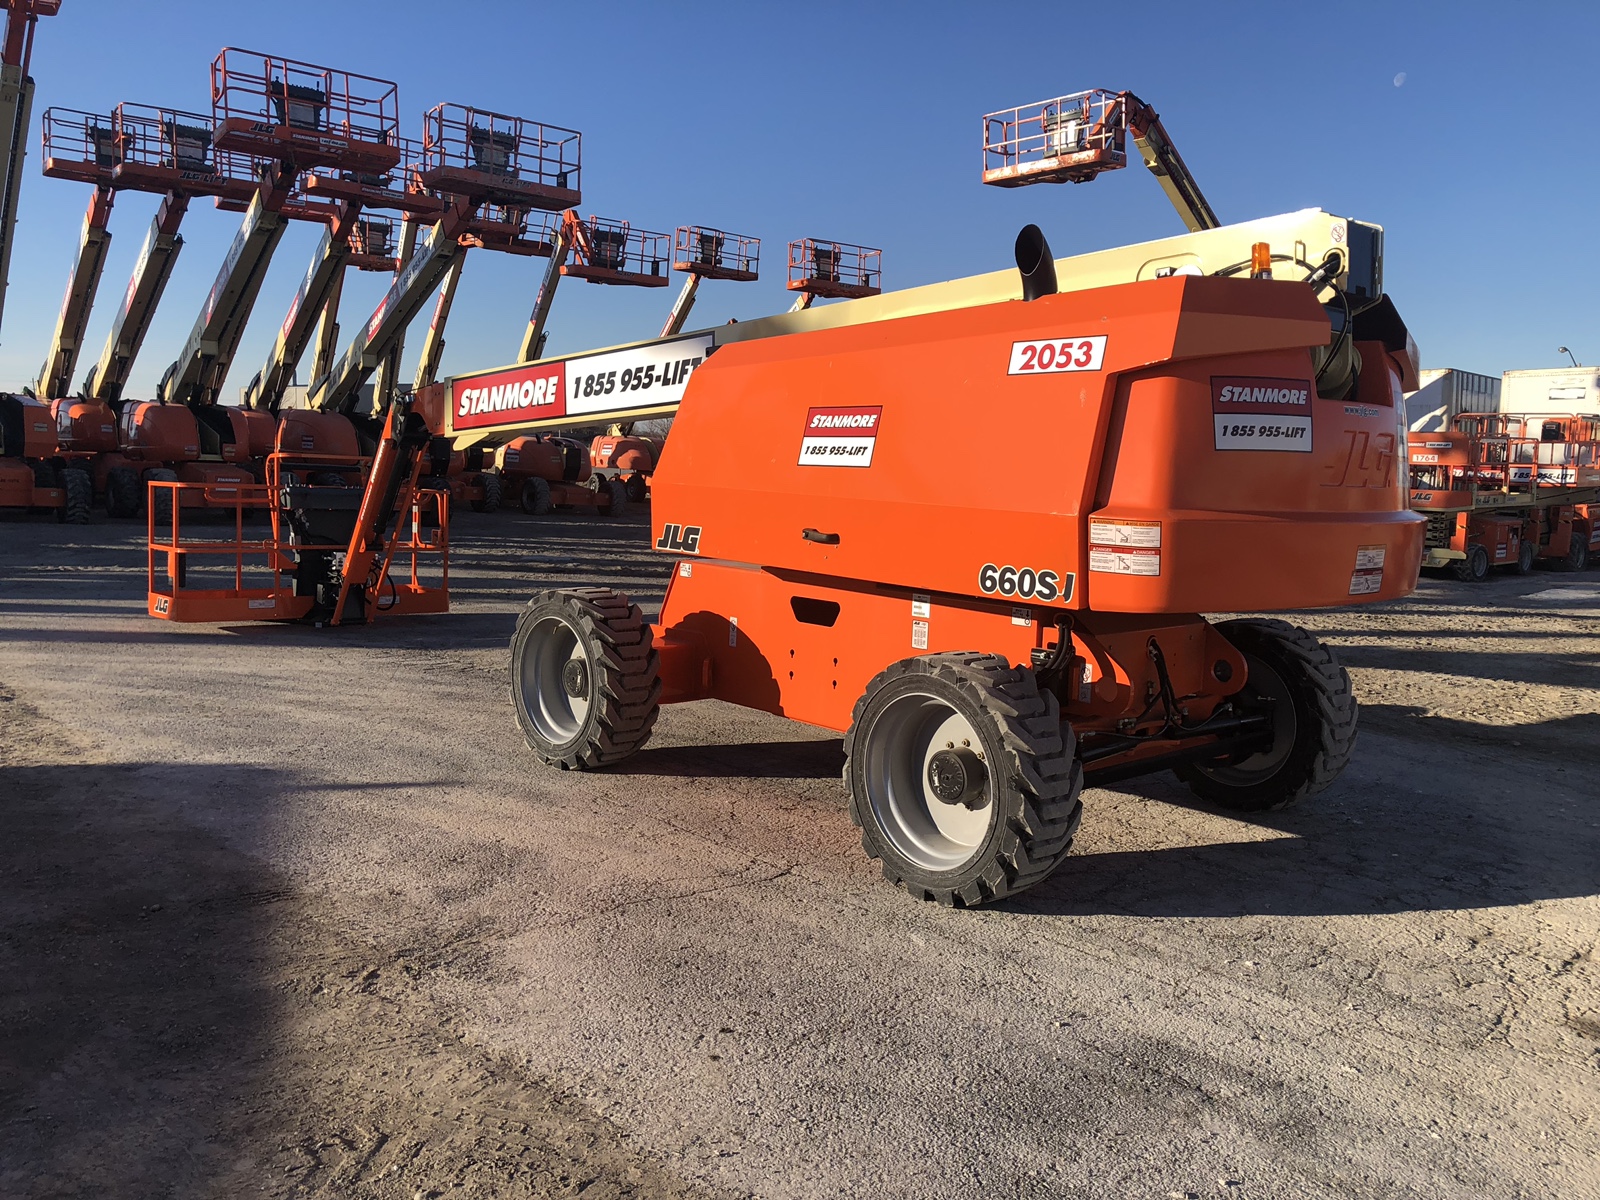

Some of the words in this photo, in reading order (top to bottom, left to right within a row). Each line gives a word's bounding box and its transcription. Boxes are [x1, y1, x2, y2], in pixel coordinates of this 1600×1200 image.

[250, 122, 276, 135] JLG
[178, 170, 201, 181] JLG
[1018, 340, 1093, 371] 2053
[458, 376, 559, 418] STANMORE
[573, 376, 582, 399] 1
[584, 371, 617, 399] 855
[1219, 385, 1308, 405] STANMORE
[809, 414, 878, 429] STANMORE
[1222, 425, 1228, 437] 1
[1230, 425, 1256, 437] 855
[1258, 425, 1307, 439] 955-LIFT
[804, 446, 810, 455] 1
[810, 446, 828, 456] 855
[829, 446, 868, 456] 955-LIFT
[1415, 454, 1436, 462] 1764
[1411, 492, 1433, 502] JLG
[656, 523, 702, 554] JLG
[978, 563, 1076, 604] 660SJ
[154, 597, 169, 615] JLG
